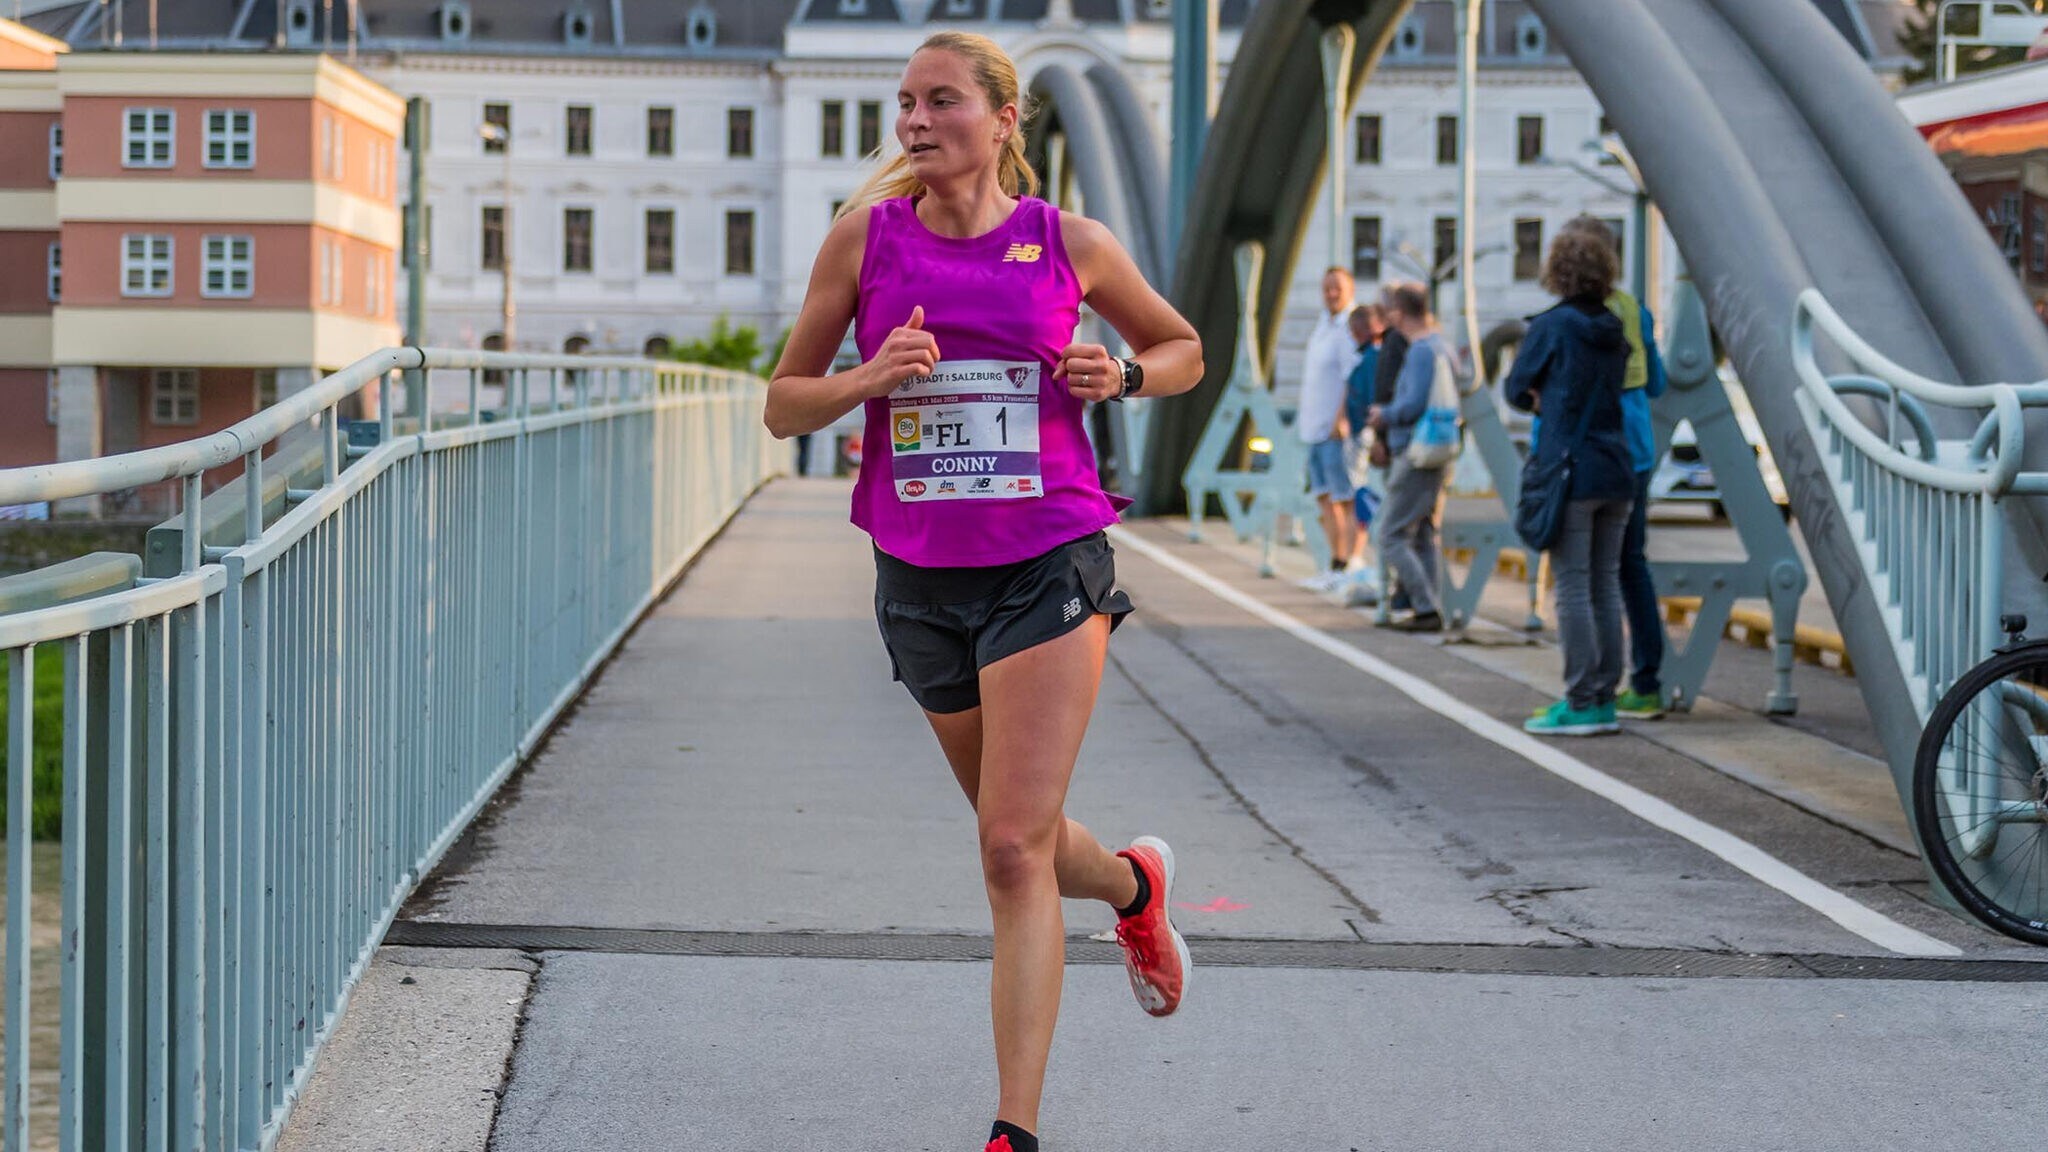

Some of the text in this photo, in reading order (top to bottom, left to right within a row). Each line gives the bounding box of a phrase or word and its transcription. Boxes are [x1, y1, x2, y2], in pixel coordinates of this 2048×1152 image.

[915, 373, 944, 384] STADT
[951, 372, 1003, 382] SALZBURG
[943, 395, 959, 403] 2022
[900, 421, 914, 431] Bio
[936, 406, 1007, 447] FL 1
[931, 456, 998, 473] CONNY
[940, 480, 955, 489] dm
